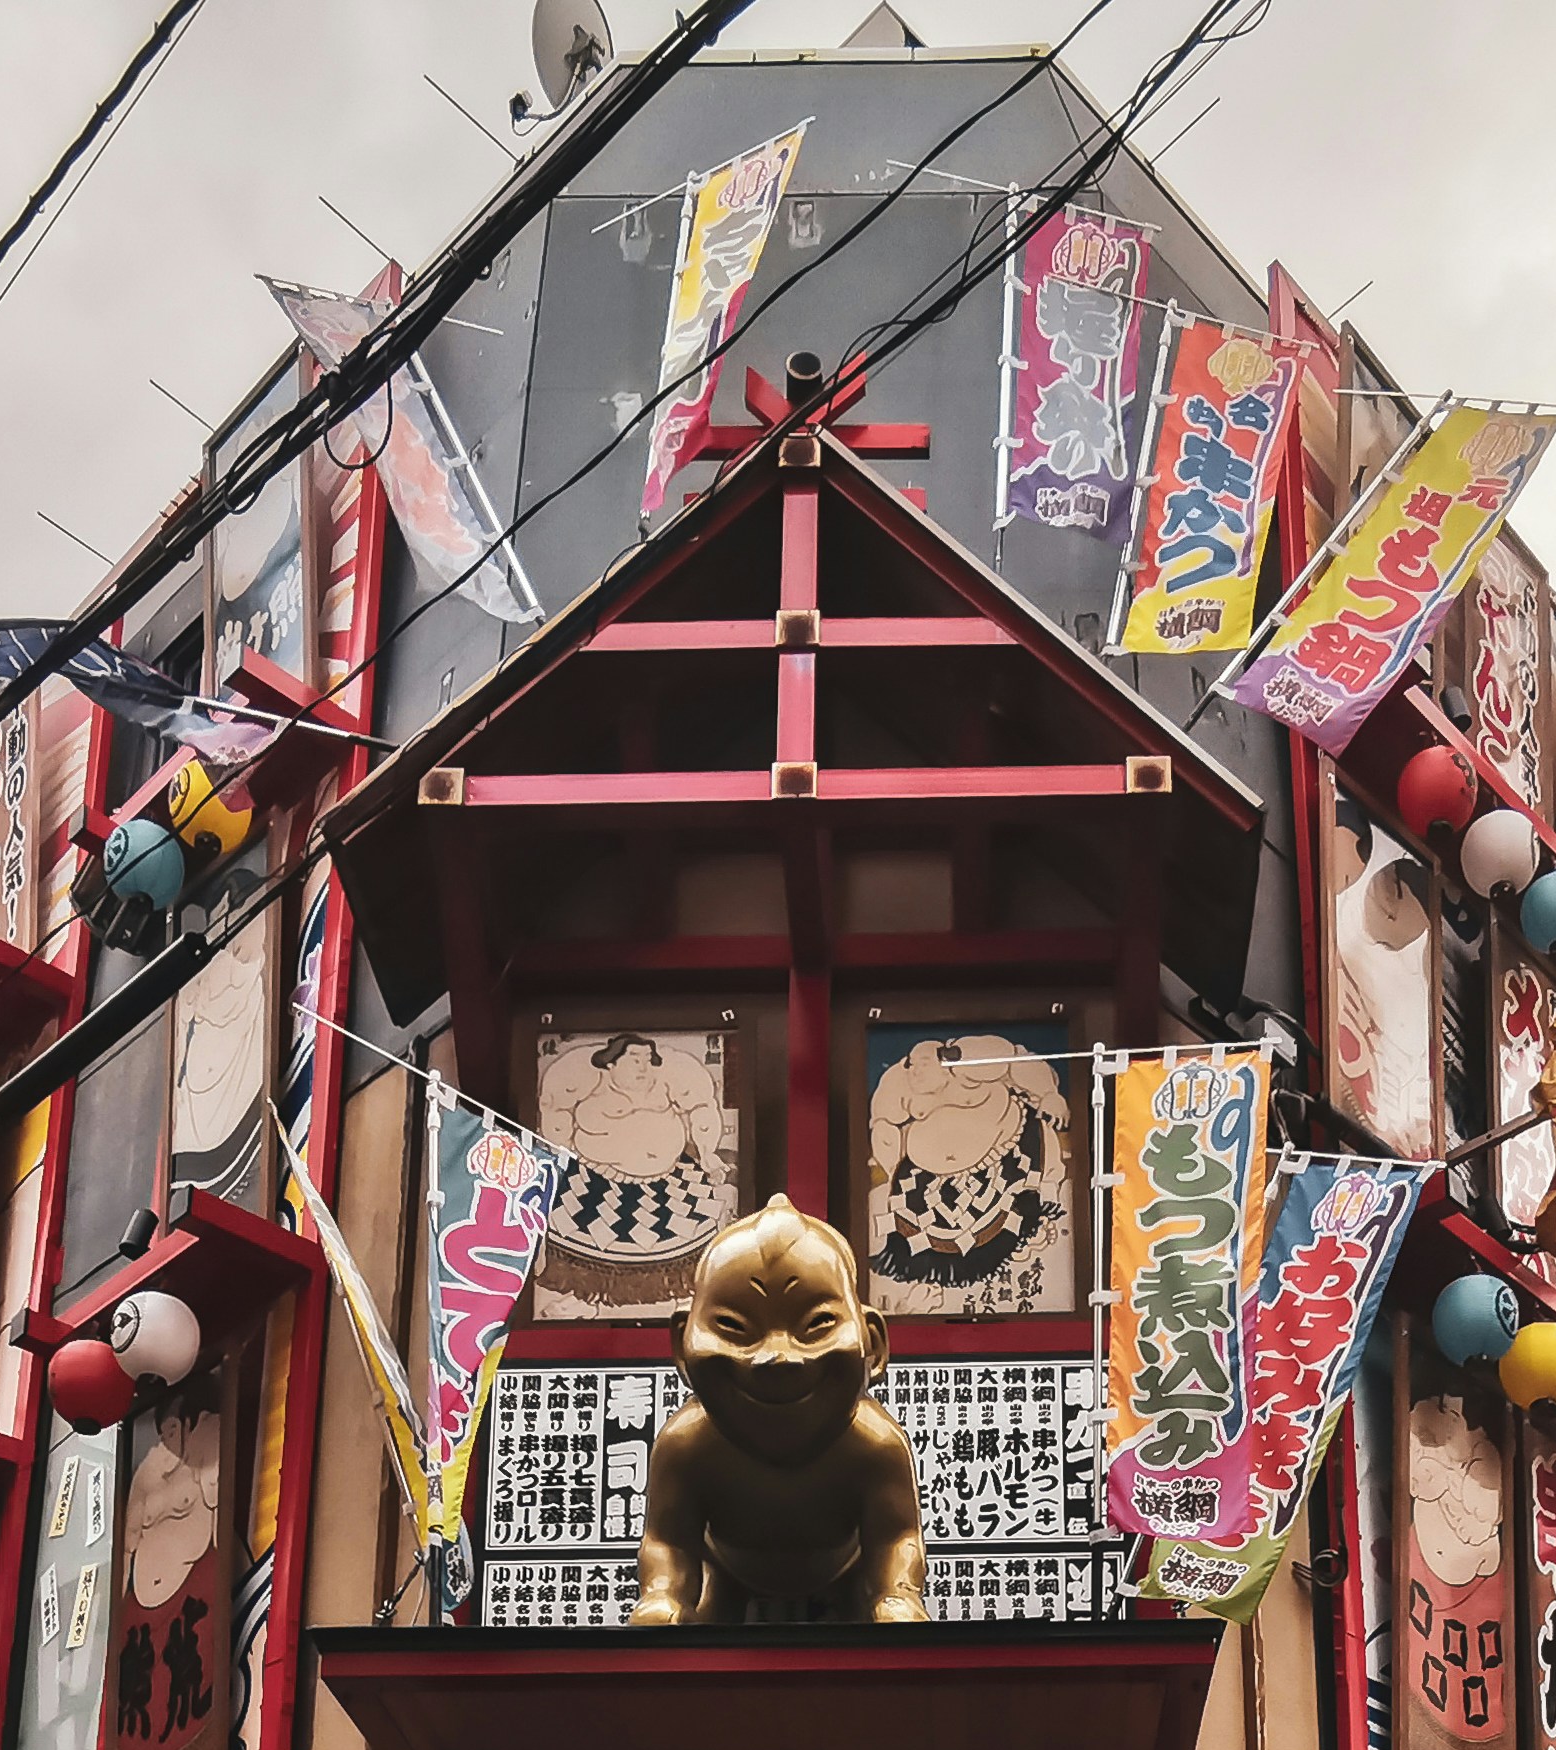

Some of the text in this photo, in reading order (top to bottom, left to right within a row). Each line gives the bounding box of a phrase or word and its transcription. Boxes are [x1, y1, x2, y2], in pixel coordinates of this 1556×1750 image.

[1155, 432, 1257, 594] 串かつ
[1403, 477, 1510, 527] 元祖
[1286, 523, 1442, 696] もつ鍋
[1131, 1123, 1238, 1470] もつ煮込み
[499, 1375, 518, 1410] 小結
[521, 1375, 542, 1410] 関脇
[547, 1375, 571, 1410] 大関
[573, 1375, 598, 1410] 横綱
[894, 1369, 911, 1405] 前頭
[913, 1369, 929, 1405] 前頭
[932, 1369, 951, 1405] 小結
[953, 1368, 973, 1405] 関脇
[977, 1368, 998, 1404] 大関
[1002, 1367, 1027, 1404] 横綱
[1031, 1367, 1058, 1404] 横綱
[606, 1375, 653, 1494] 寿司
[494, 1436, 517, 1543] まぐろ握り
[515, 1435, 542, 1543] 串かつロール
[538, 1435, 570, 1541] 握り五貫盛り
[569, 1435, 599, 1540] 握り七貫盛り
[930, 1430, 952, 1538] じゃがいも
[952, 1430, 975, 1537] 鶏もも
[976, 1429, 1003, 1537] 豚バラ
[1003, 1428, 1031, 1536] ホルモン
[1134, 1476, 1220, 1493] 日本一の串かつ
[604, 1496, 627, 1538] 自慢
[1131, 1488, 1219, 1528] 横綱
[491, 1566, 511, 1602] 小結
[514, 1566, 535, 1602] 小結
[537, 1566, 557, 1602] 小結
[560, 1566, 582, 1602] 関脇
[586, 1566, 610, 1601] 大関
[614, 1566, 640, 1601] 横綱
[933, 1561, 951, 1597] 小結
[955, 1561, 975, 1598] 関脇
[979, 1561, 1001, 1597] 大関
[1004, 1559, 1030, 1597] 横綱
[1033, 1559, 1059, 1597] 横綱
[1158, 1560, 1239, 1599] 横綱
